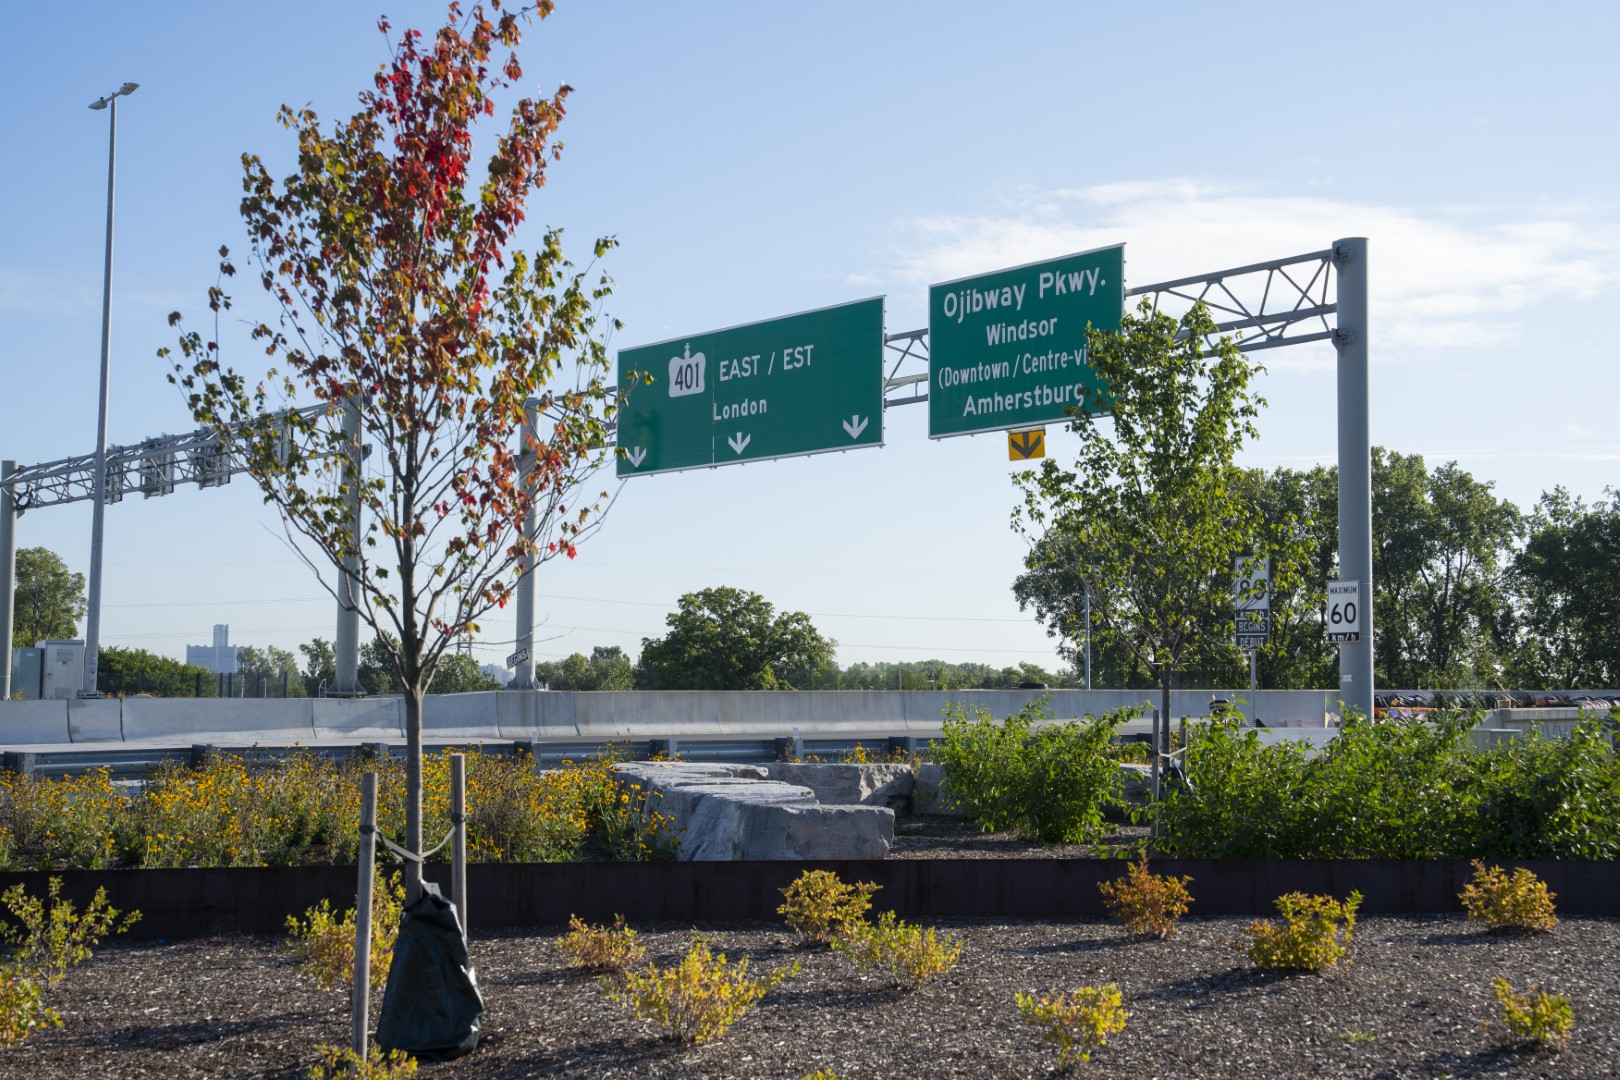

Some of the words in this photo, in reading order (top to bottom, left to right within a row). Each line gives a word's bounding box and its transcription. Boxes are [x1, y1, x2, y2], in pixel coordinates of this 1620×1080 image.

[943, 283, 1026, 324] Ojibway
[1039, 267, 1106, 299] Pkwy.
[986, 317, 1058, 346] Windsor
[719, 355, 760, 381] EAST
[768, 352, 775, 376] /
[783, 345, 815, 370] EST
[938, 360, 1009, 390] (Downtown
[1023, 344, 1090, 374] Centre-vi
[674, 362, 700, 391] 401
[713, 398, 767, 421] London
[963, 383, 1085, 417] Amherstburg
[1330, 586, 1357, 595] MAXIMUM
[1331, 602, 1356, 624] 60
[1238, 621, 1266, 632] BEGINS
[1331, 633, 1356, 642] km/h
[1240, 635, 1264, 648] DÉBUT
